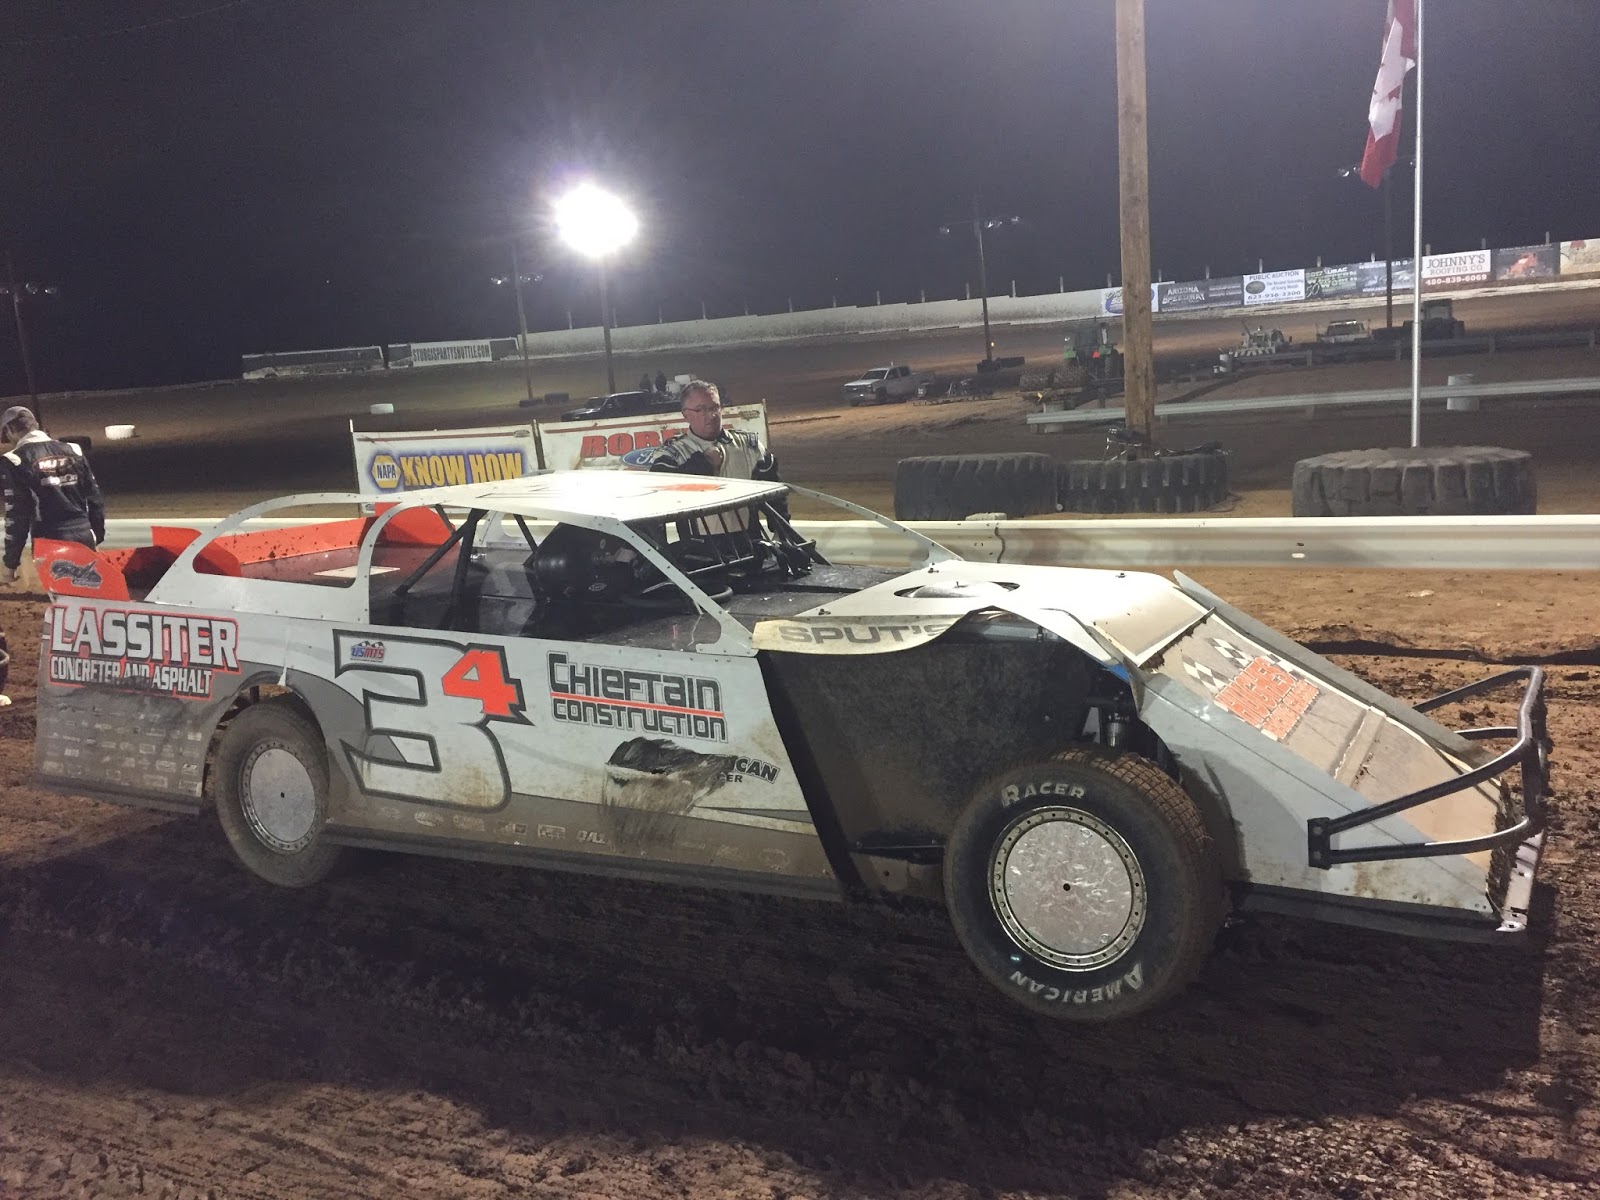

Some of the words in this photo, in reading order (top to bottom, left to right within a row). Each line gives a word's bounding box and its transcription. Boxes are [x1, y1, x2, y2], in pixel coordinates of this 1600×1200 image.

[1427, 254, 1486, 269] JOHNNY'S
[1430, 266, 1467, 276] ROOFING
[1272, 270, 1300, 279] AUCTION
[1425, 274, 1487, 286] 480-839-6069
[1162, 293, 1205, 305] SPEEDWAY
[1168, 286, 1200, 296] ARIZONA
[376, 463, 397, 479] NAPA
[400, 455, 467, 487] KNOW
[469, 453, 522, 484] HOW
[50, 606, 240, 671] LASSITER
[152, 667, 213, 694] ASPHALT
[553, 698, 728, 743] CONSTRUCTION
[1001, 781, 1086, 807] RACER
[1010, 963, 1145, 1004] AMERICAN
